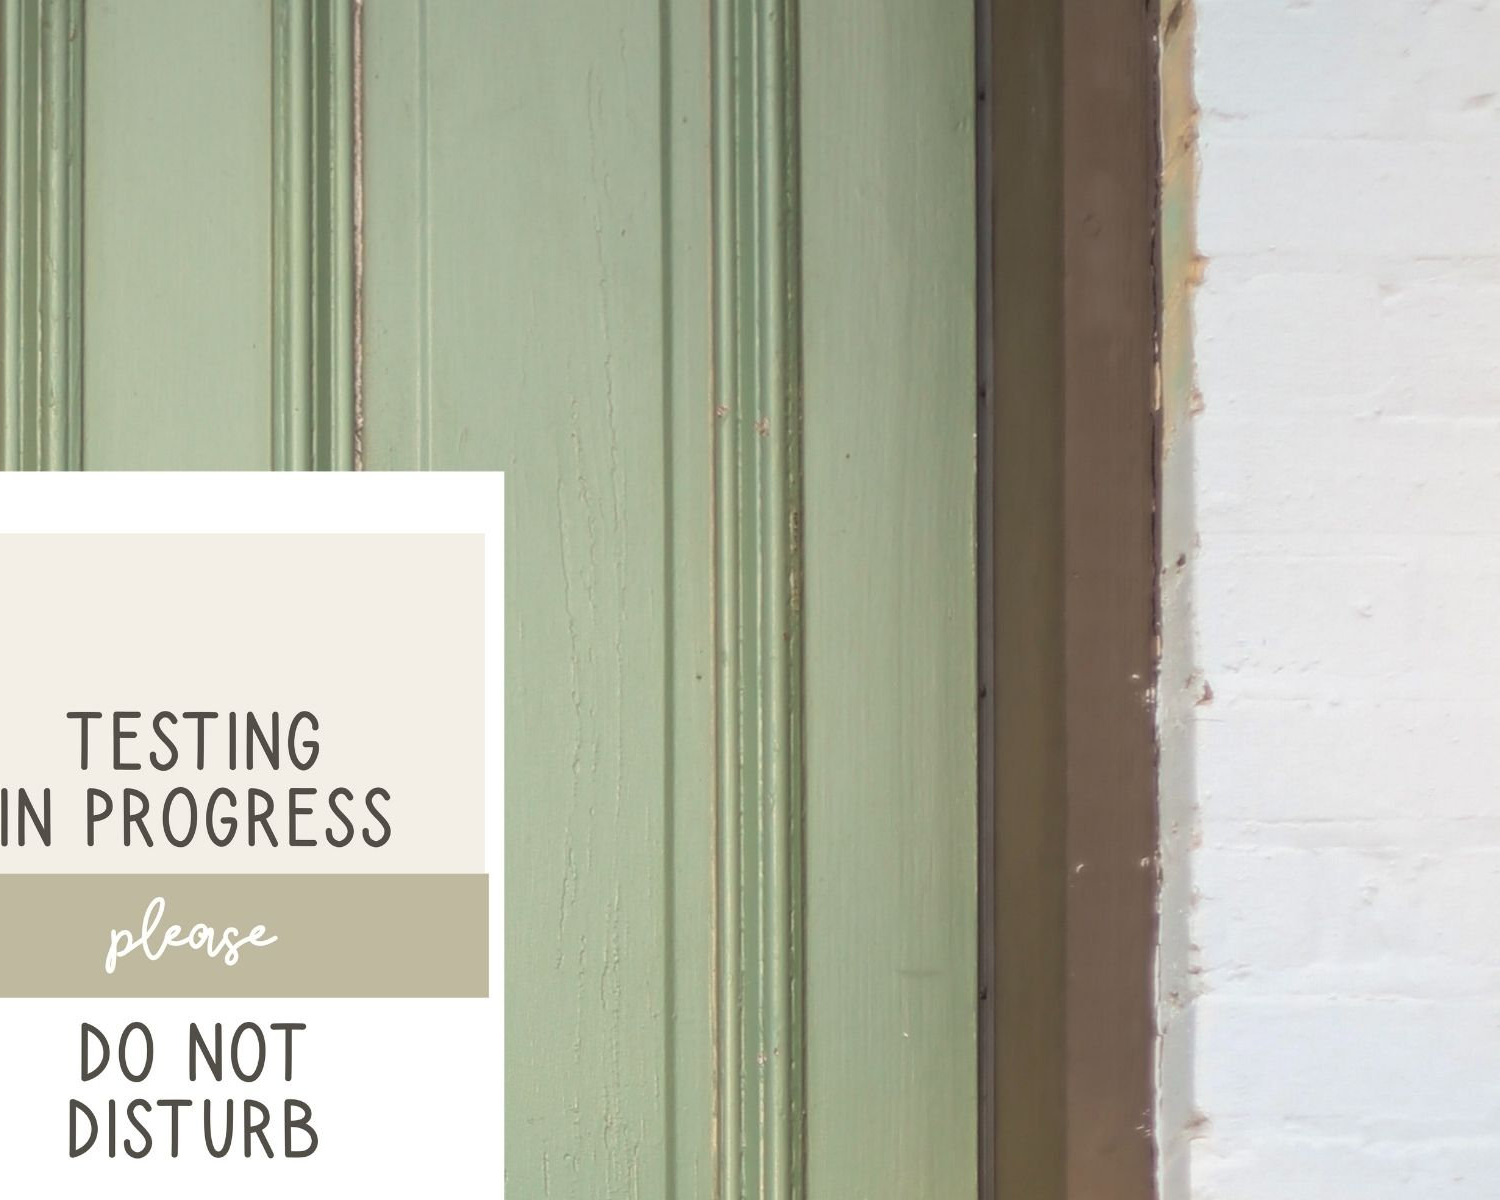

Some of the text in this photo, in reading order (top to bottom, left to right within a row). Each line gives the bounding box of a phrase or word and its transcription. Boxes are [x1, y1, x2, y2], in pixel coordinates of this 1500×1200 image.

[66, 710, 320, 772] TESTING
[0, 786, 392, 848] IN PROGRESS
[104, 896, 279, 974] please
[81, 1021, 307, 1083] DO NOT
[69, 1098, 319, 1159] DISTURB
